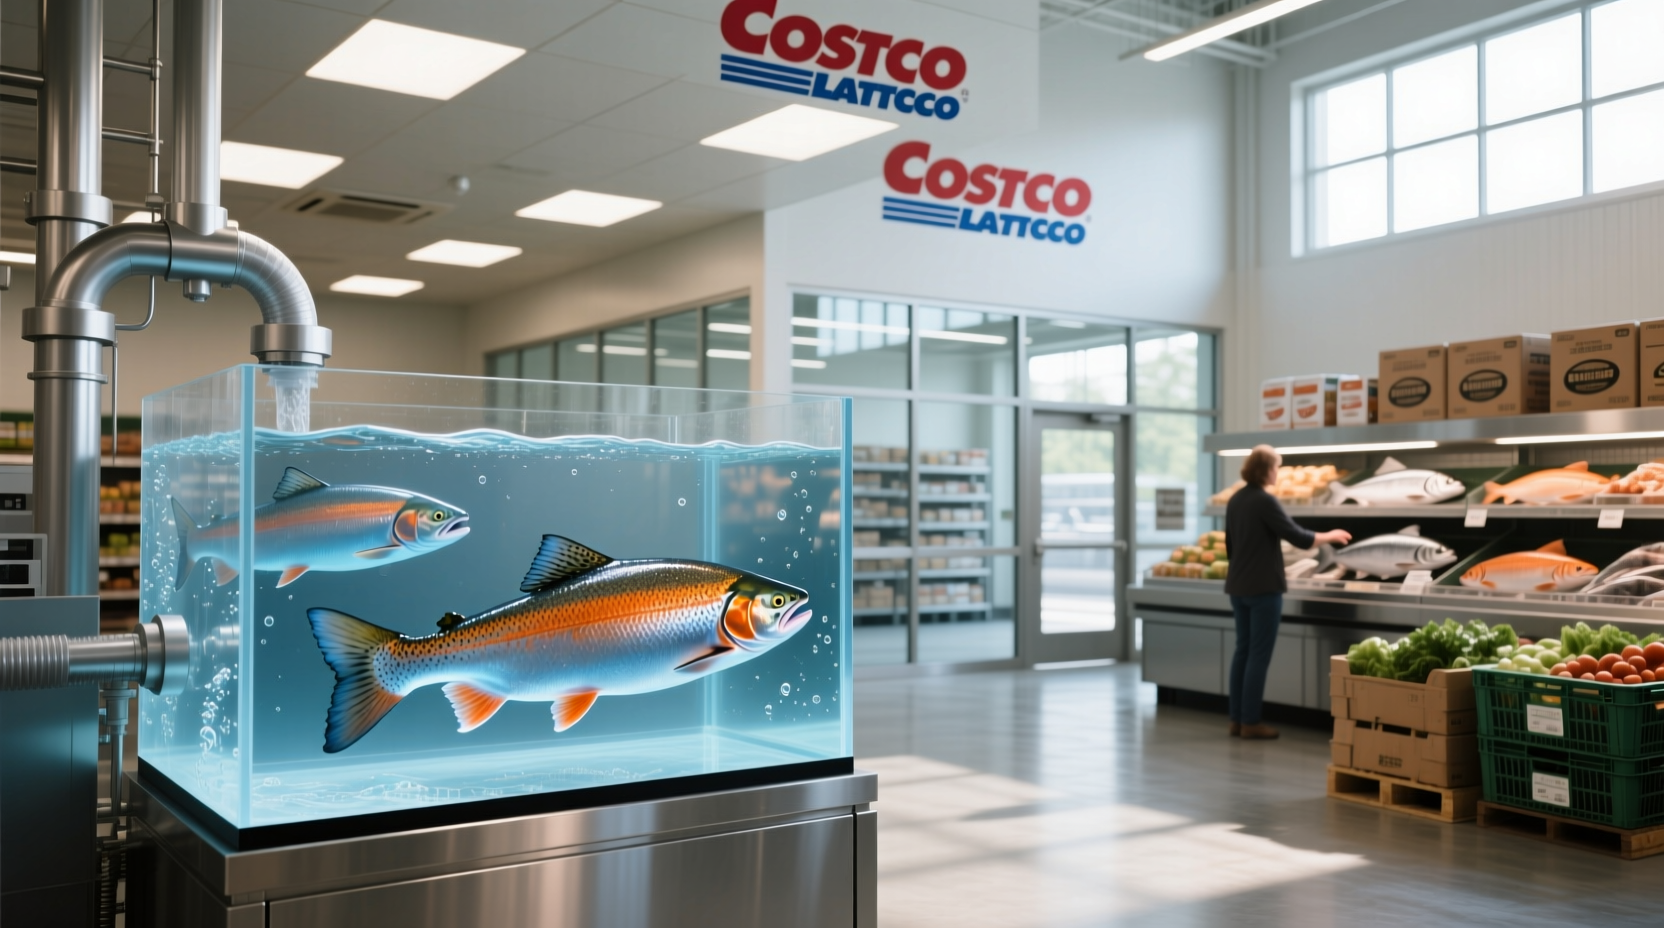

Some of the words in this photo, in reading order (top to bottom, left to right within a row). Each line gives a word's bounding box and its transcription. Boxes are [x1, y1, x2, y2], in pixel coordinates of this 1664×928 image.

[721, 0, 967, 91] COSTCO
[812, 72, 960, 120] LATTCCO
[883, 140, 1092, 217] COSTCO
[959, 208, 1086, 245] LATTCCO
